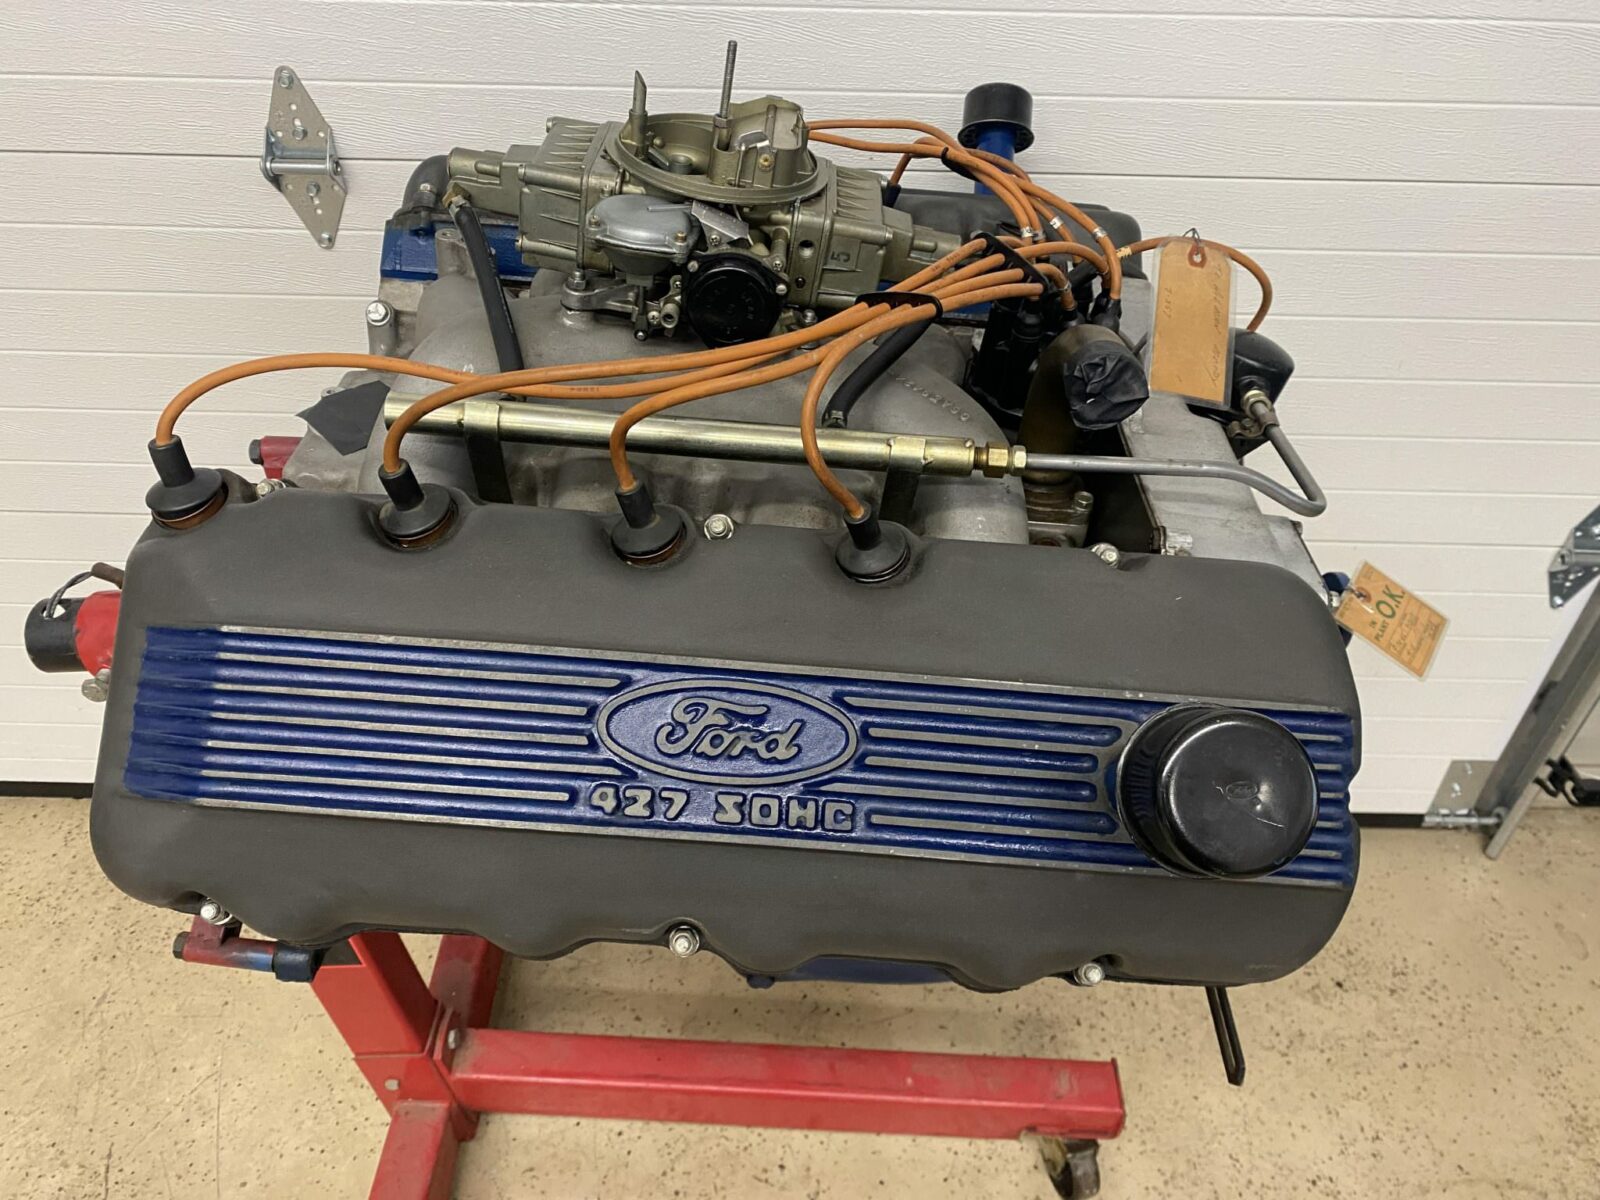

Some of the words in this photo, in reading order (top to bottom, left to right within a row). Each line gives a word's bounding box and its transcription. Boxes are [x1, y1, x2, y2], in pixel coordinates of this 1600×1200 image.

[1374, 620, 1390, 642] PLANT
[655, 698, 802, 760] Ford
[591, 783, 689, 820] 427
[714, 791, 854, 831] SOHC
